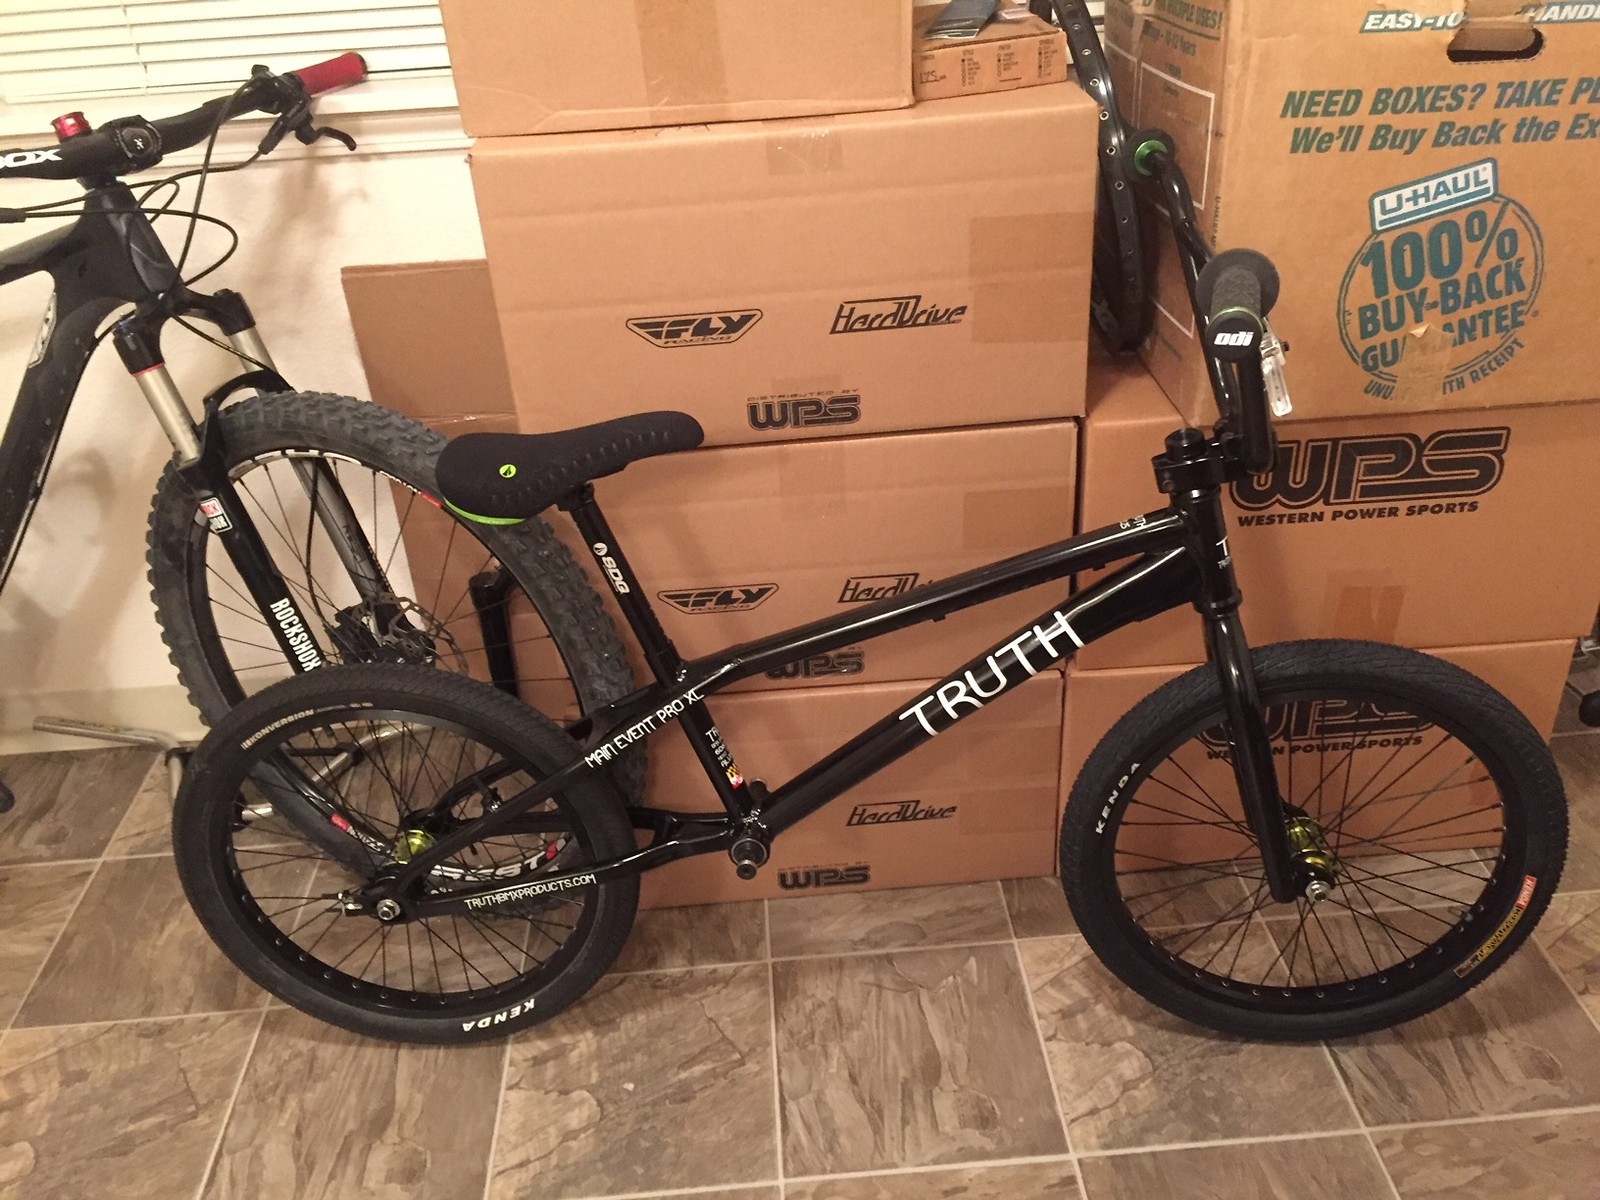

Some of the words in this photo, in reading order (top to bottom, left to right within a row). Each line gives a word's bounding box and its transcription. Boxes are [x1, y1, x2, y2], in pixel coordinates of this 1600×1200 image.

[1280, 89, 1363, 118] NEED
[1369, 83, 1487, 116] BOXES?
[1493, 78, 1568, 109] TAKE
[1289, 125, 1364, 154] We'll
[1368, 124, 1428, 155] Buy
[1432, 119, 1506, 148] Back
[1512, 115, 1560, 143] the
[0, 149, 62, 169] OX
[1379, 169, 1489, 216] U-HAUL
[1360, 203, 1518, 299] 100%
[1358, 259, 1526, 340] BUY-BACK
[631, 313, 758, 341] FLY
[1442, 377, 1466, 395] ITH
[1469, 337, 1525, 383] RECEIPT
[747, 394, 861, 431] WPS
[1229, 426, 1511, 511] WPS
[1237, 511, 1324, 527] WESTERN
[1331, 507, 1399, 521] POWER
[1405, 501, 1479, 516] SPORTS
[663, 586, 774, 608] FLY
[270, 598, 322, 672] ROCKSHOX
[899, 611, 1086, 736] TRUTH
[613, 716, 657, 749] EVENT
[656, 699, 685, 724] PRO
[683, 687, 705, 705] XL
[1291, 741, 1352, 754] POWER
[1359, 736, 1422, 749] SPORTS
[1095, 763, 1141, 834] KENDA
[464, 874, 597, 910] TRUTHBMXPRODUCTS.COM
[778, 864, 871, 890] WPS
[462, 998, 535, 1032] KENDA
